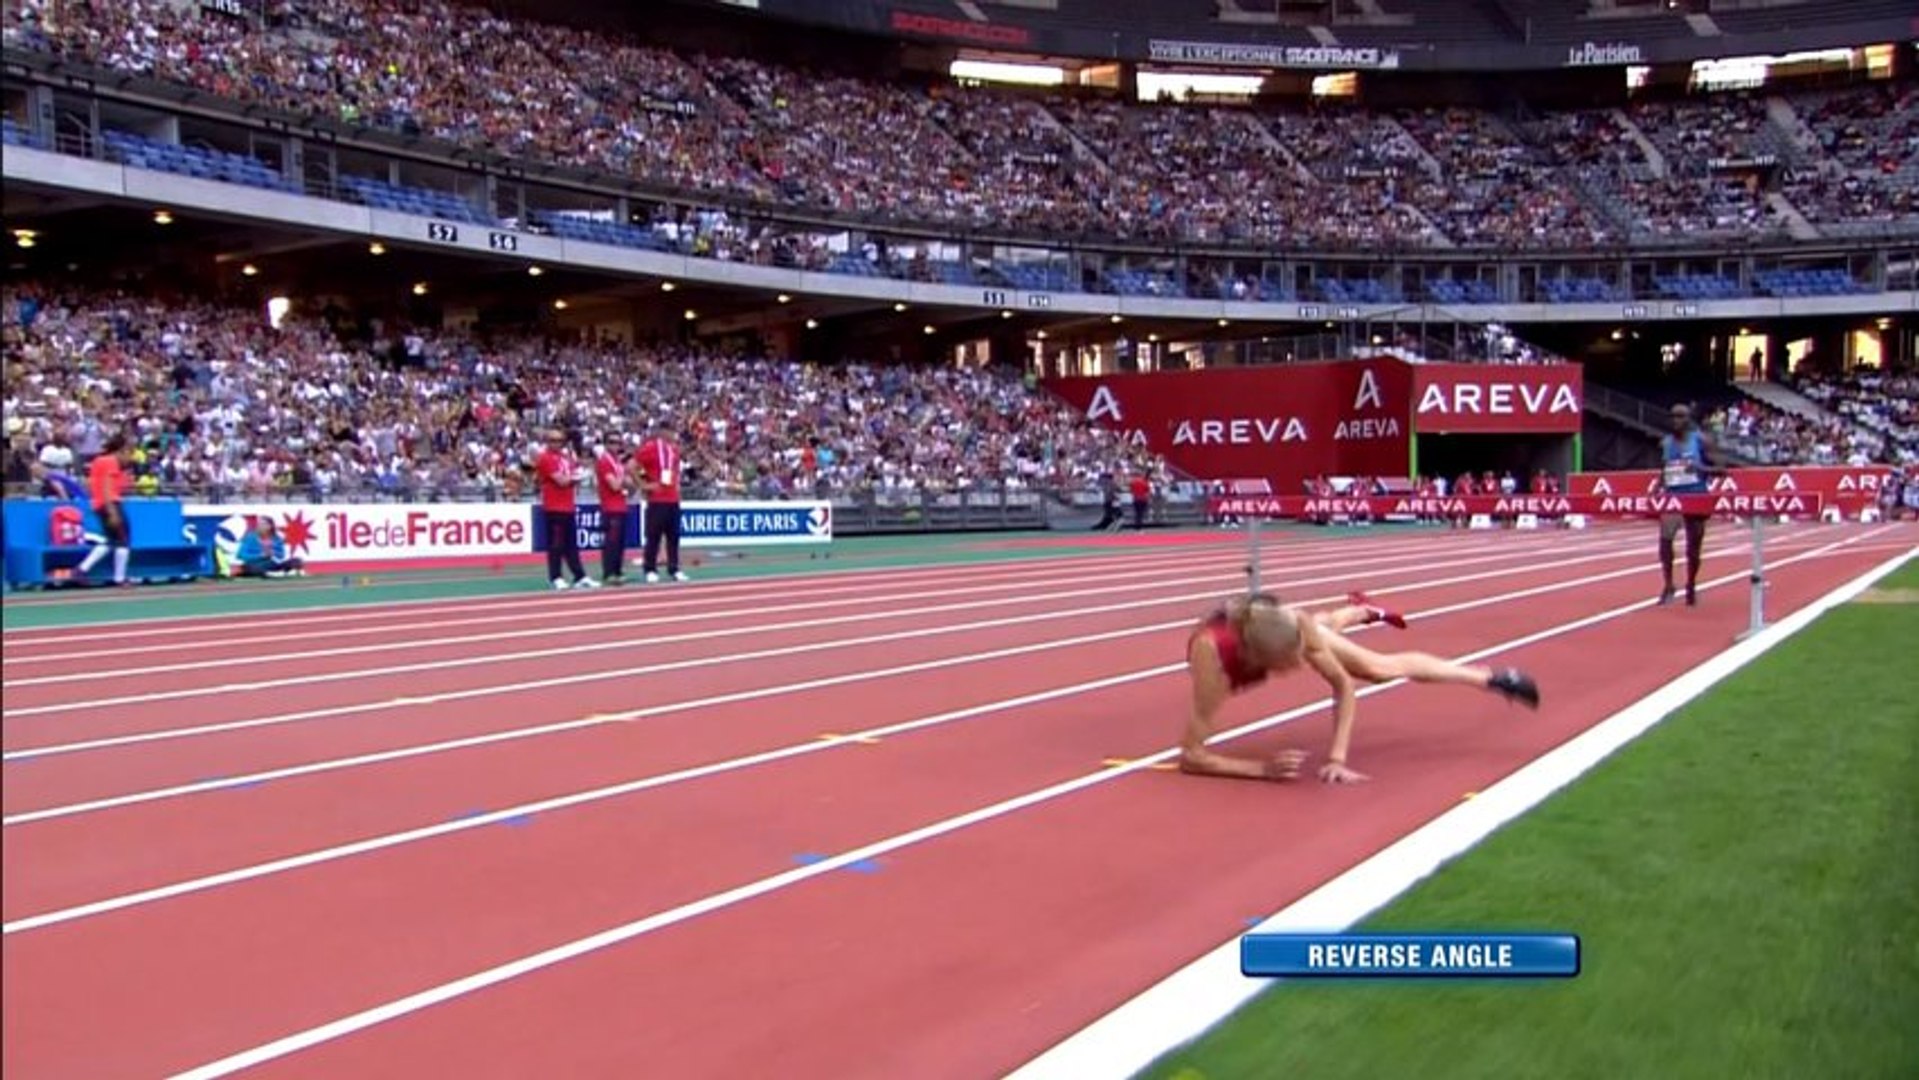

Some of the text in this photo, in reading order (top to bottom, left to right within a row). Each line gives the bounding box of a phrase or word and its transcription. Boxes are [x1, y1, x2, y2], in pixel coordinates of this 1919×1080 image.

[1584, 42, 1639, 64] Parisien
[1417, 382, 1580, 415] AREVA
[1172, 418, 1308, 446] AREVA
[1334, 418, 1399, 441] AREVA
[1219, 501, 1281, 512] AREVA
[1304, 499, 1371, 512] AREVA
[1396, 499, 1466, 512] AREVA
[1495, 498, 1570, 511] AREVA
[1600, 497, 1683, 511] AREVA
[1715, 496, 1804, 511] AREVA
[679, 513, 798, 532] AIRIE DE PARIS
